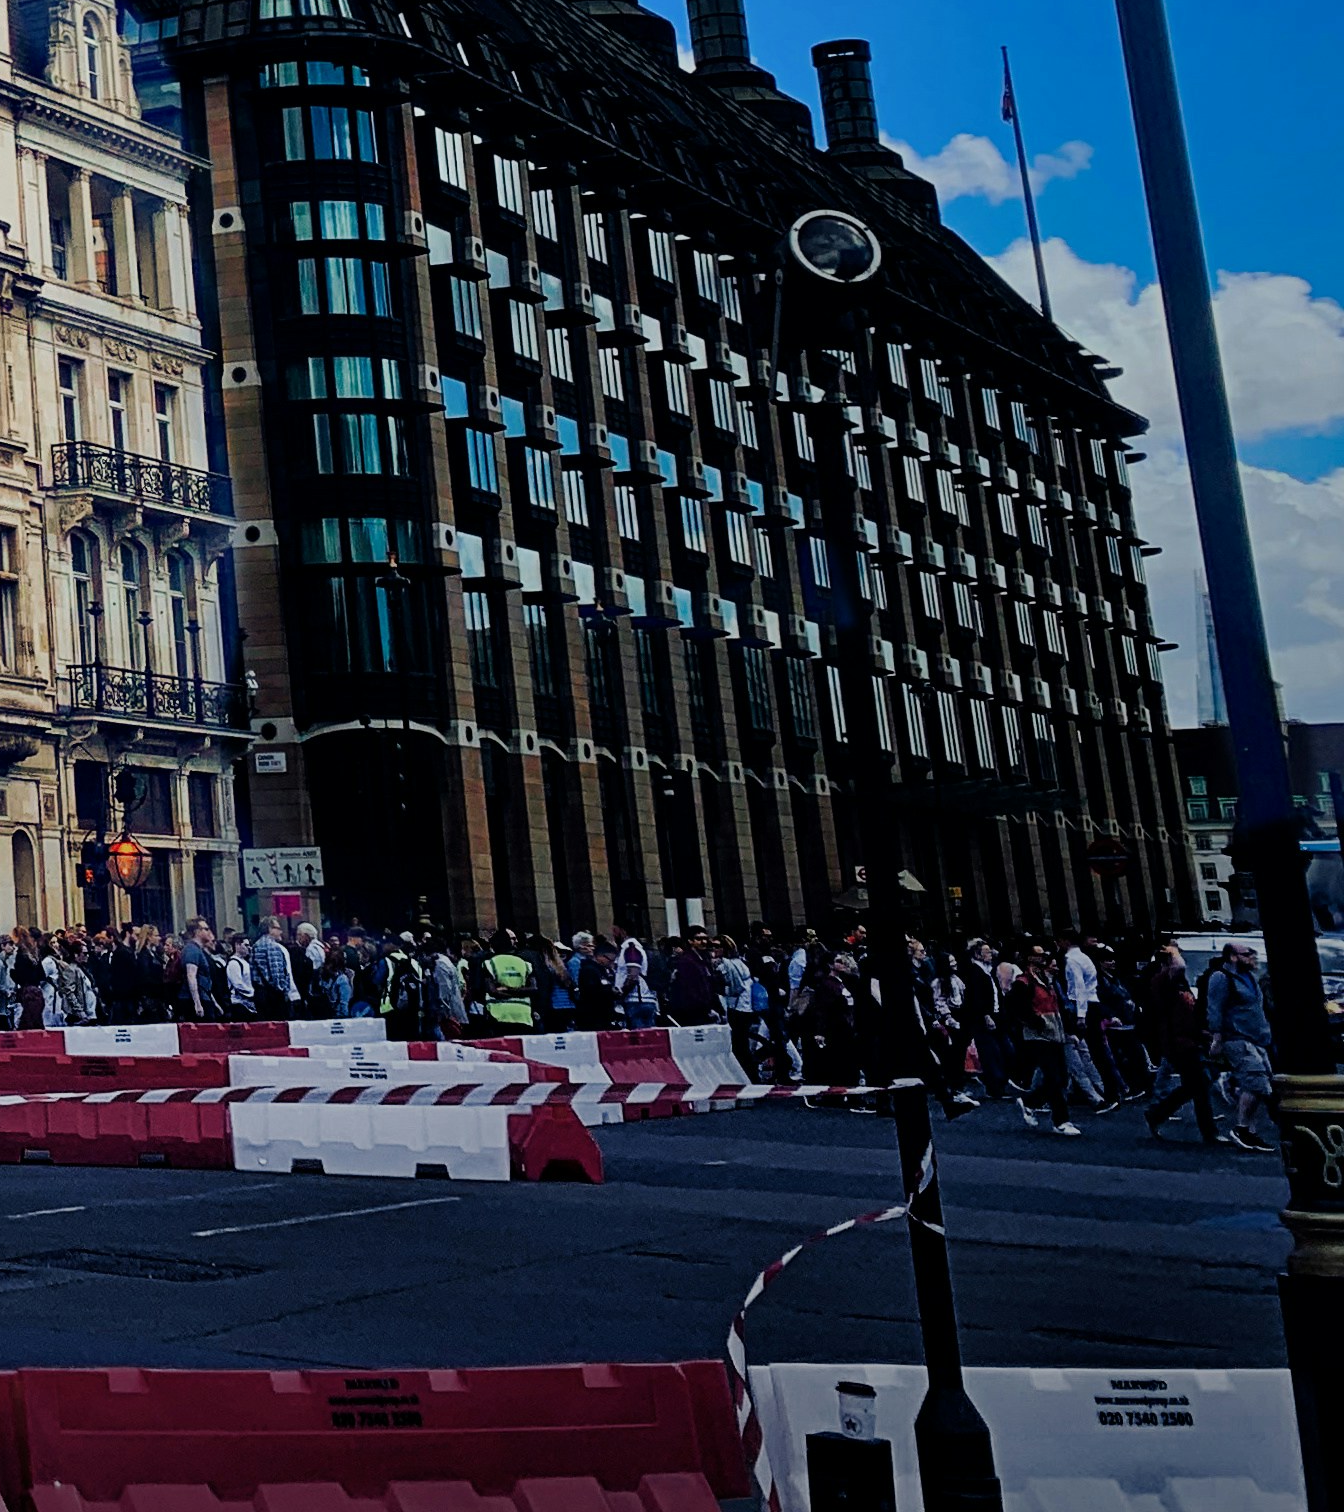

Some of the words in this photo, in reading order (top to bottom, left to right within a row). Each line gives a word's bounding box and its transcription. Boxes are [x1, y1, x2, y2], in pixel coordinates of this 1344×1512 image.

[1097, 1411, 1124, 1426] 020
[1125, 1411, 1159, 1426] 7540
[1160, 1411, 1194, 1426] 2500
